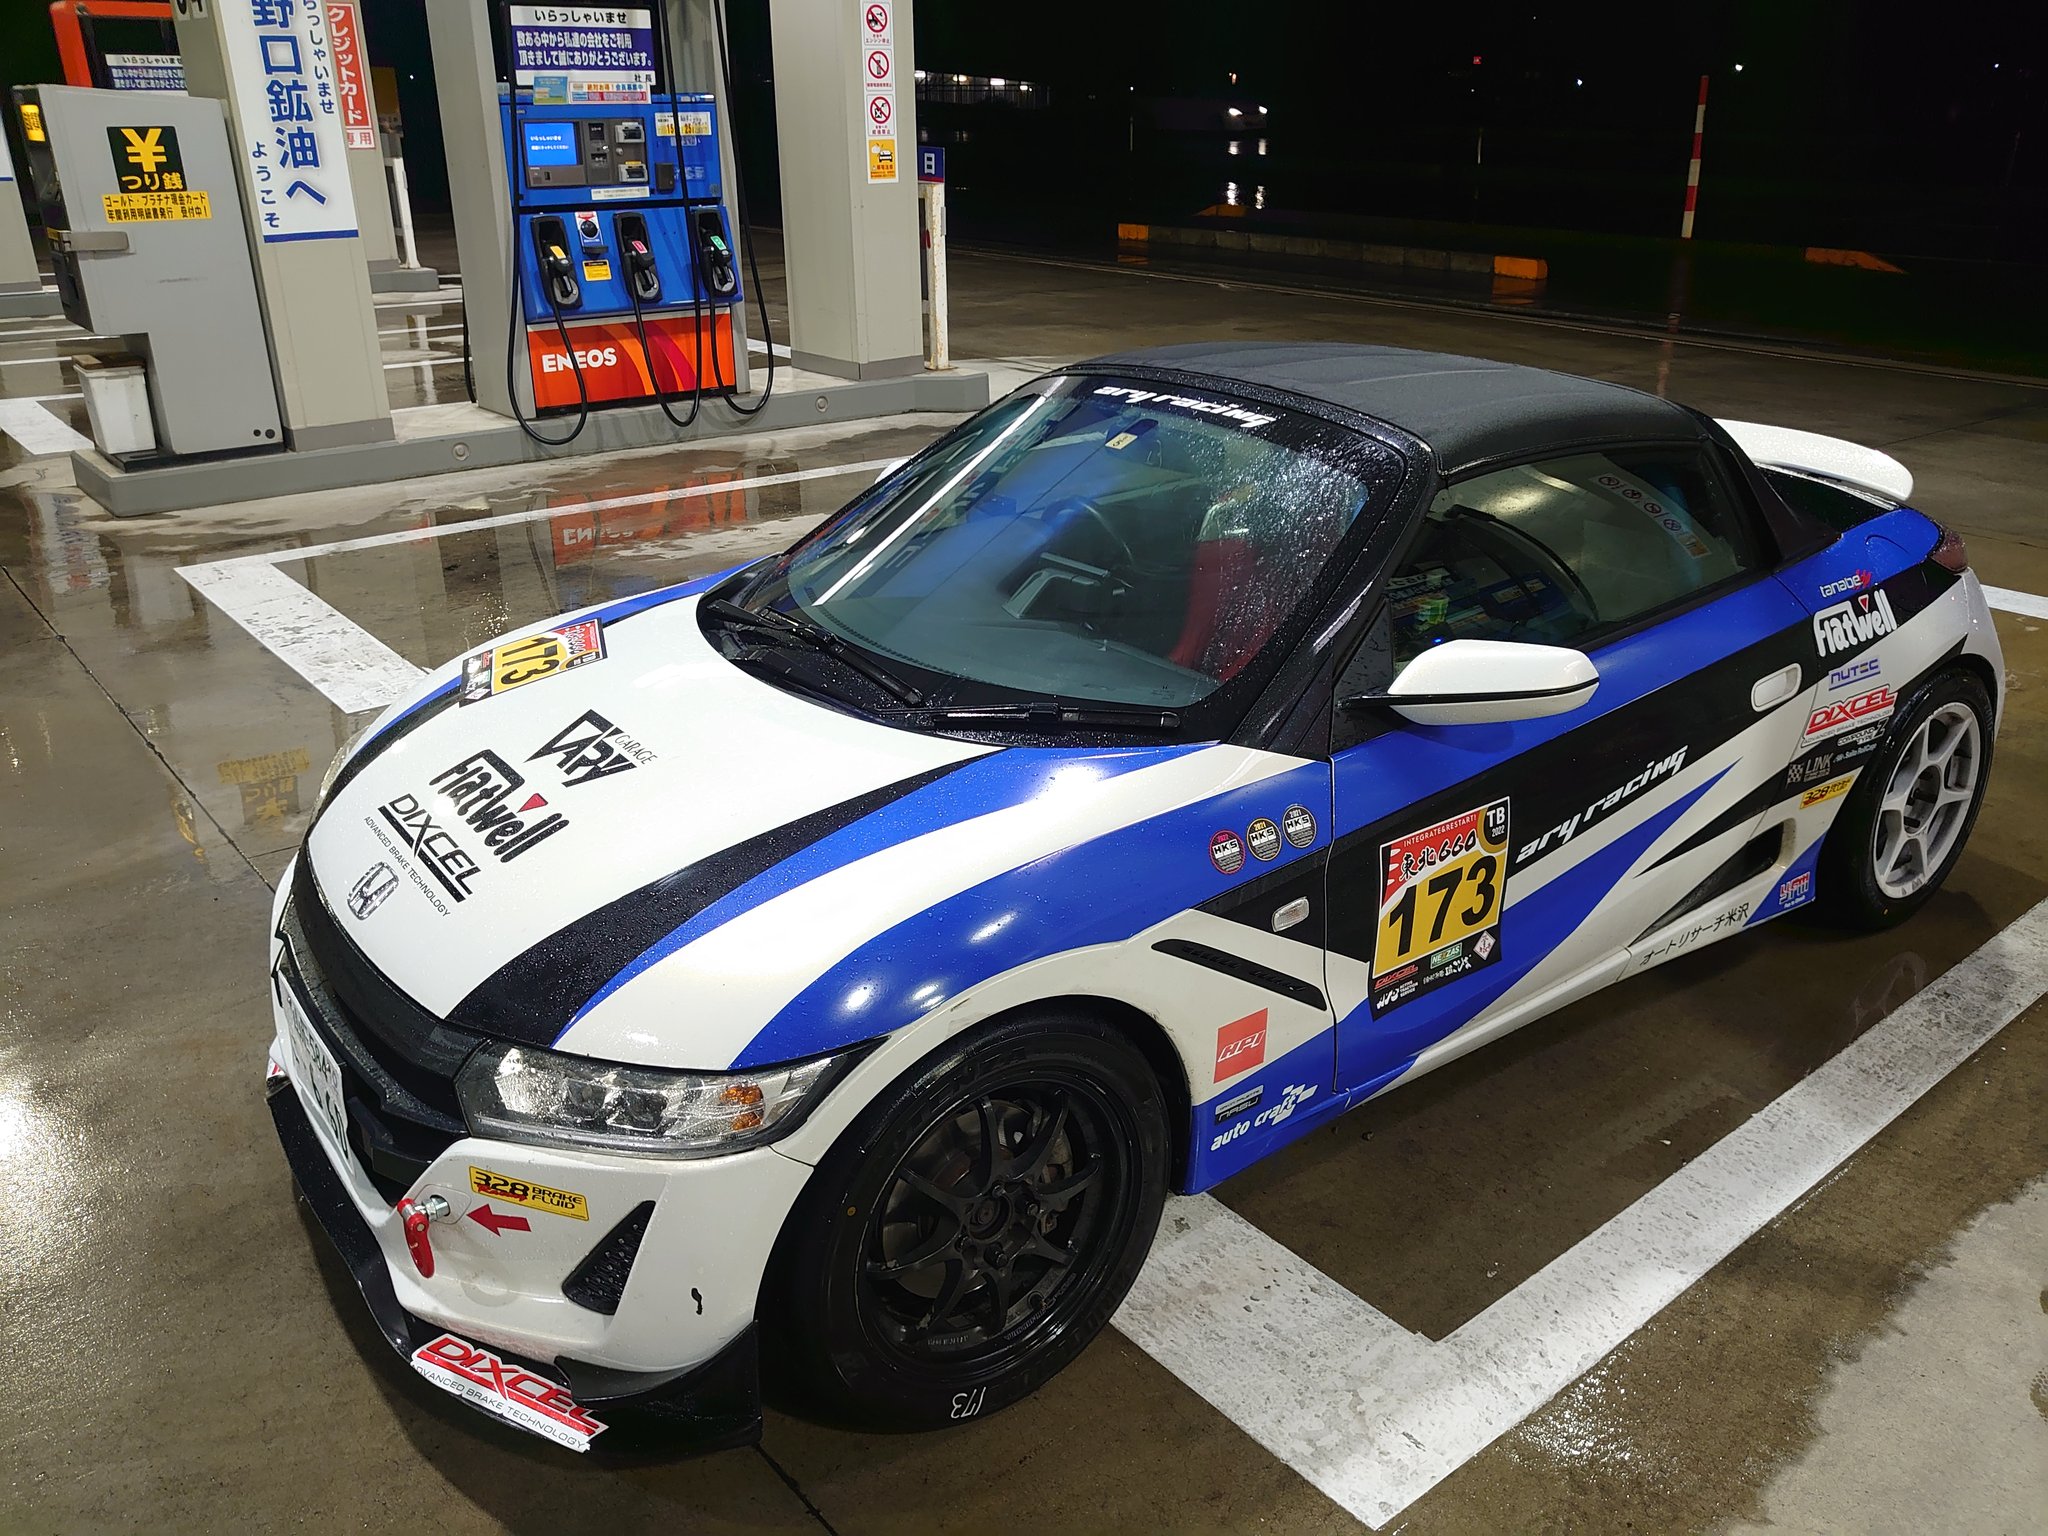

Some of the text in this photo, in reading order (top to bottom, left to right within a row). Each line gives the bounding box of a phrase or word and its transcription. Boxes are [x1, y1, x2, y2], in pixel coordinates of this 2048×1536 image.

[534, 9, 627, 24] いらっしゃいませ
[516, 31, 633, 48] 数ある中から私達の会社をご利用
[328, 7, 362, 125] クレジットカード
[121, 172, 183, 190] つり銭
[252, 141, 280, 228] ようこそ
[541, 347, 618, 373] ENEOS
[1093, 386, 1277, 428] ary racing
[1820, 574, 1863, 598] tanabe
[1813, 588, 1897, 657] Flatwell
[501, 636, 560, 685] 173
[1808, 686, 1895, 730] DIXCEL
[614, 734, 658, 765] GARAGE
[1486, 806, 1506, 829] TB
[1516, 745, 1688, 864] ary racing
[1249, 826, 1277, 847] HKS
[1285, 814, 1312, 834] HKS
[1403, 813, 1477, 848] INTEGRATE&RESTART!
[1491, 824, 1506, 838] 2022
[388, 792, 482, 896] DIXCEL
[1212, 838, 1240, 860] HKS
[1400, 828, 1477, 882] 東北660
[363, 815, 452, 918] ADVANCED BRAKE TECHNOLOGY
[1388, 855, 1498, 957] 173
[1639, 902, 1750, 966] オートリサーチ米沢
[1217, 1029, 1266, 1063] HPI
[1210, 1120, 1251, 1151] auto
[1254, 1092, 1297, 1128] craft
[473, 1170, 530, 1198] 328
[532, 1186, 583, 1205] BRAKE
[531, 1194, 576, 1210] FLUID
[426, 1337, 600, 1430] DIXCEL
[465, 1387, 504, 1411] BRAKE
[506, 1405, 587, 1450] TECHNOLOGY
[950, 1386, 987, 1419] 173
